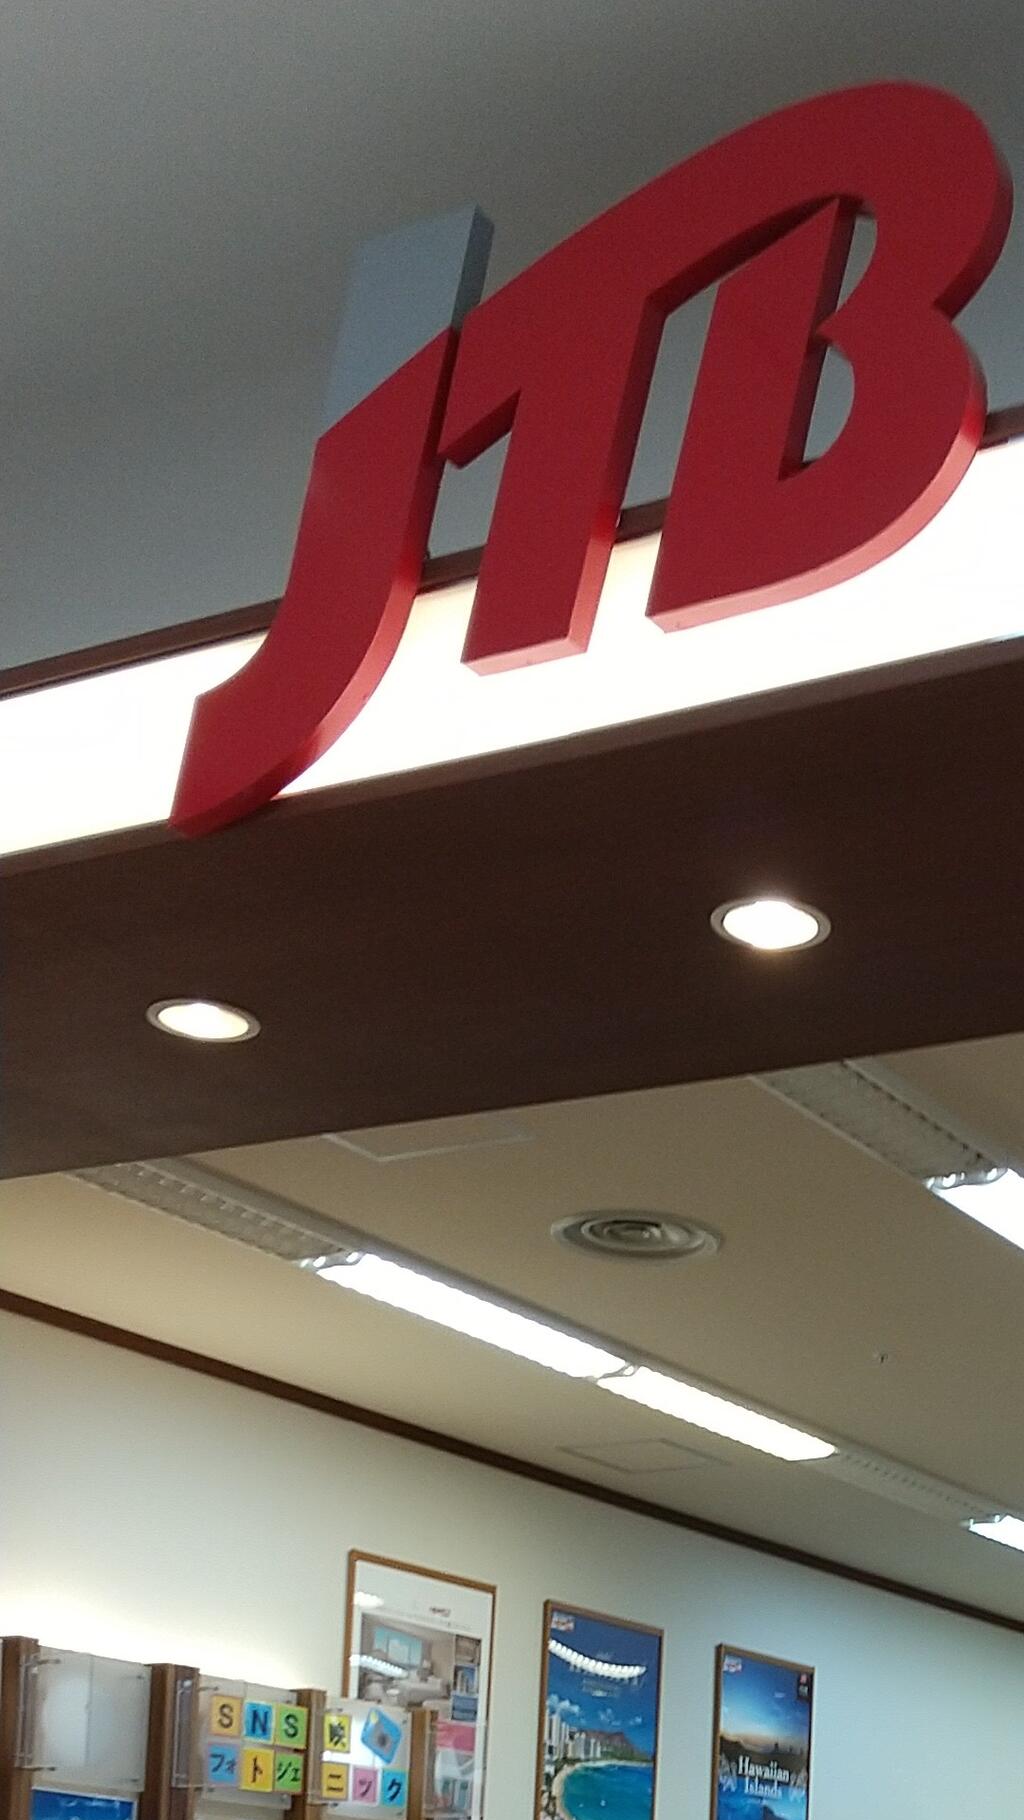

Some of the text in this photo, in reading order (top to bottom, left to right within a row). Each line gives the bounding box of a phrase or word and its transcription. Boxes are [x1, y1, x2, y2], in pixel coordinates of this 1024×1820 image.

[170, 81, 1012, 838] JTB
[737, 1756, 790, 1782] Hawaiian
[743, 1777, 782, 1800] Islands
